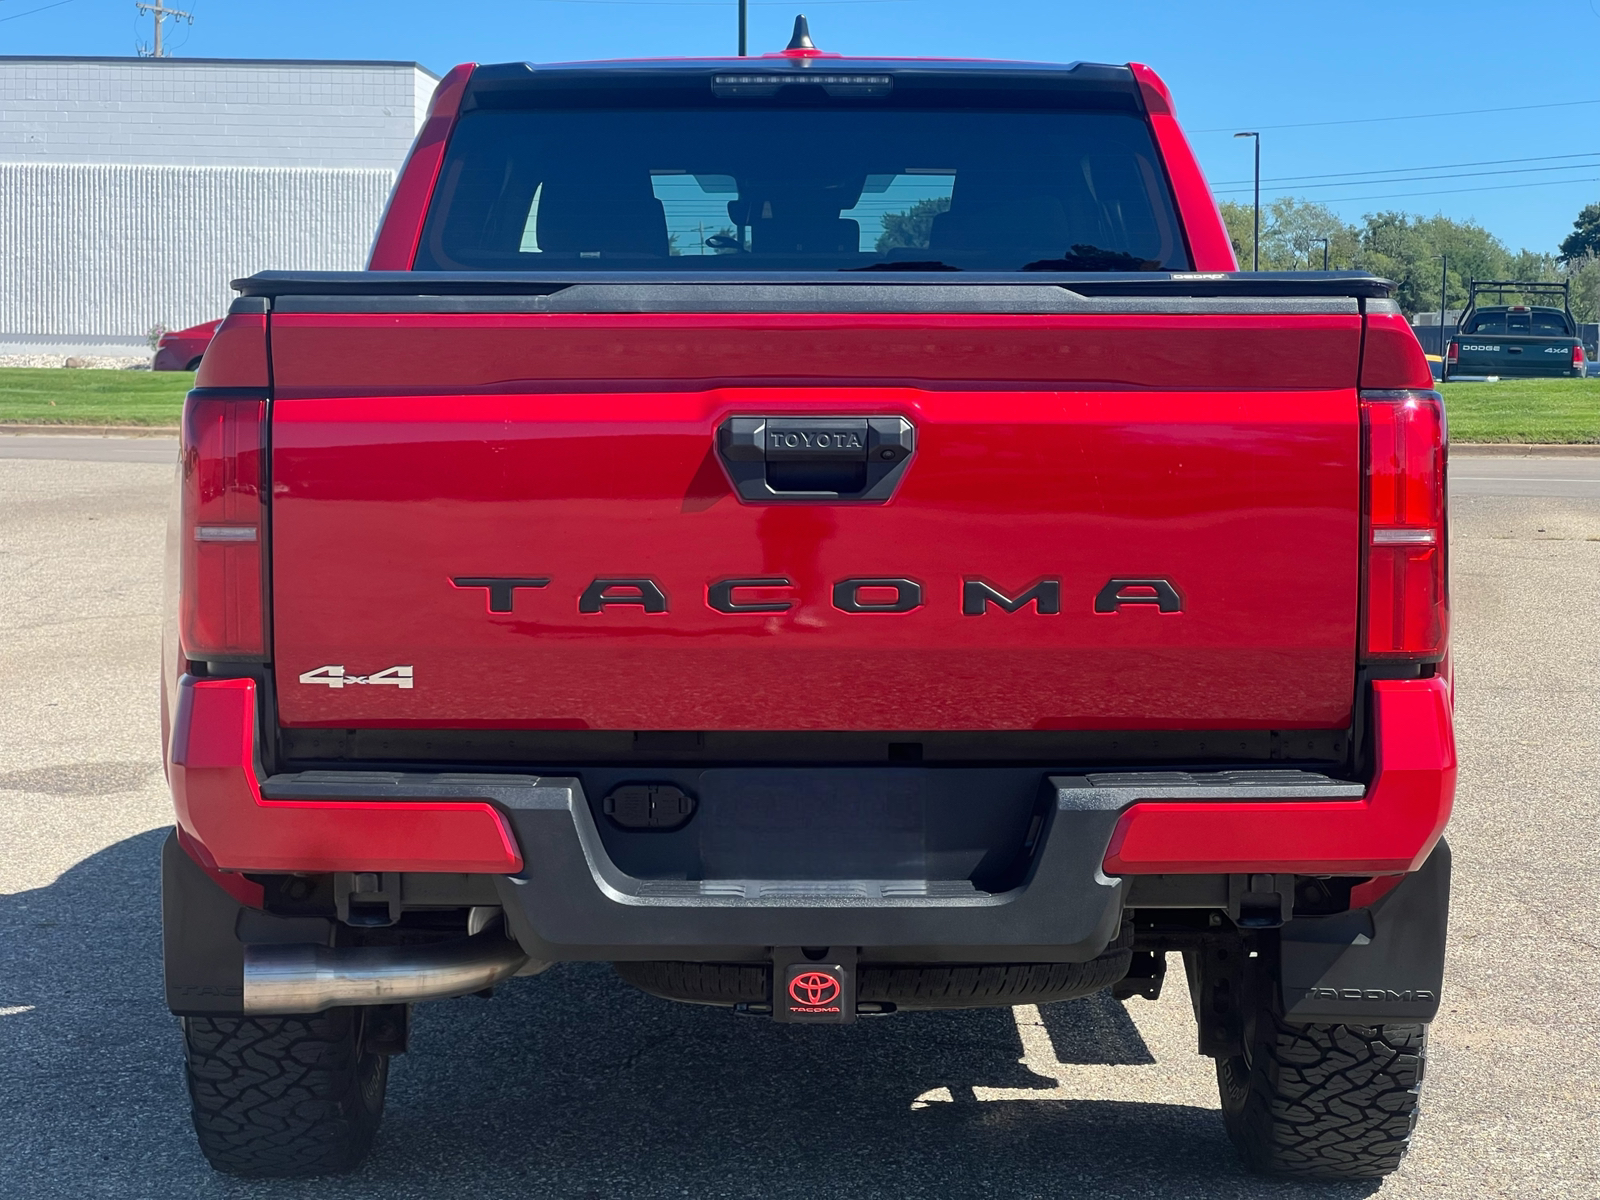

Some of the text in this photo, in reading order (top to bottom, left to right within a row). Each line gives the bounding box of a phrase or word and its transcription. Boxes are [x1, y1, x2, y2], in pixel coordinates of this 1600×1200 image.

[1462, 344, 1500, 352] DODGE
[770, 432, 862, 448] TOYOTA
[448, 577, 1185, 615] TACOMA
[299, 665, 413, 688] 4x4
[1287, 987, 1436, 1002] TACOMA
